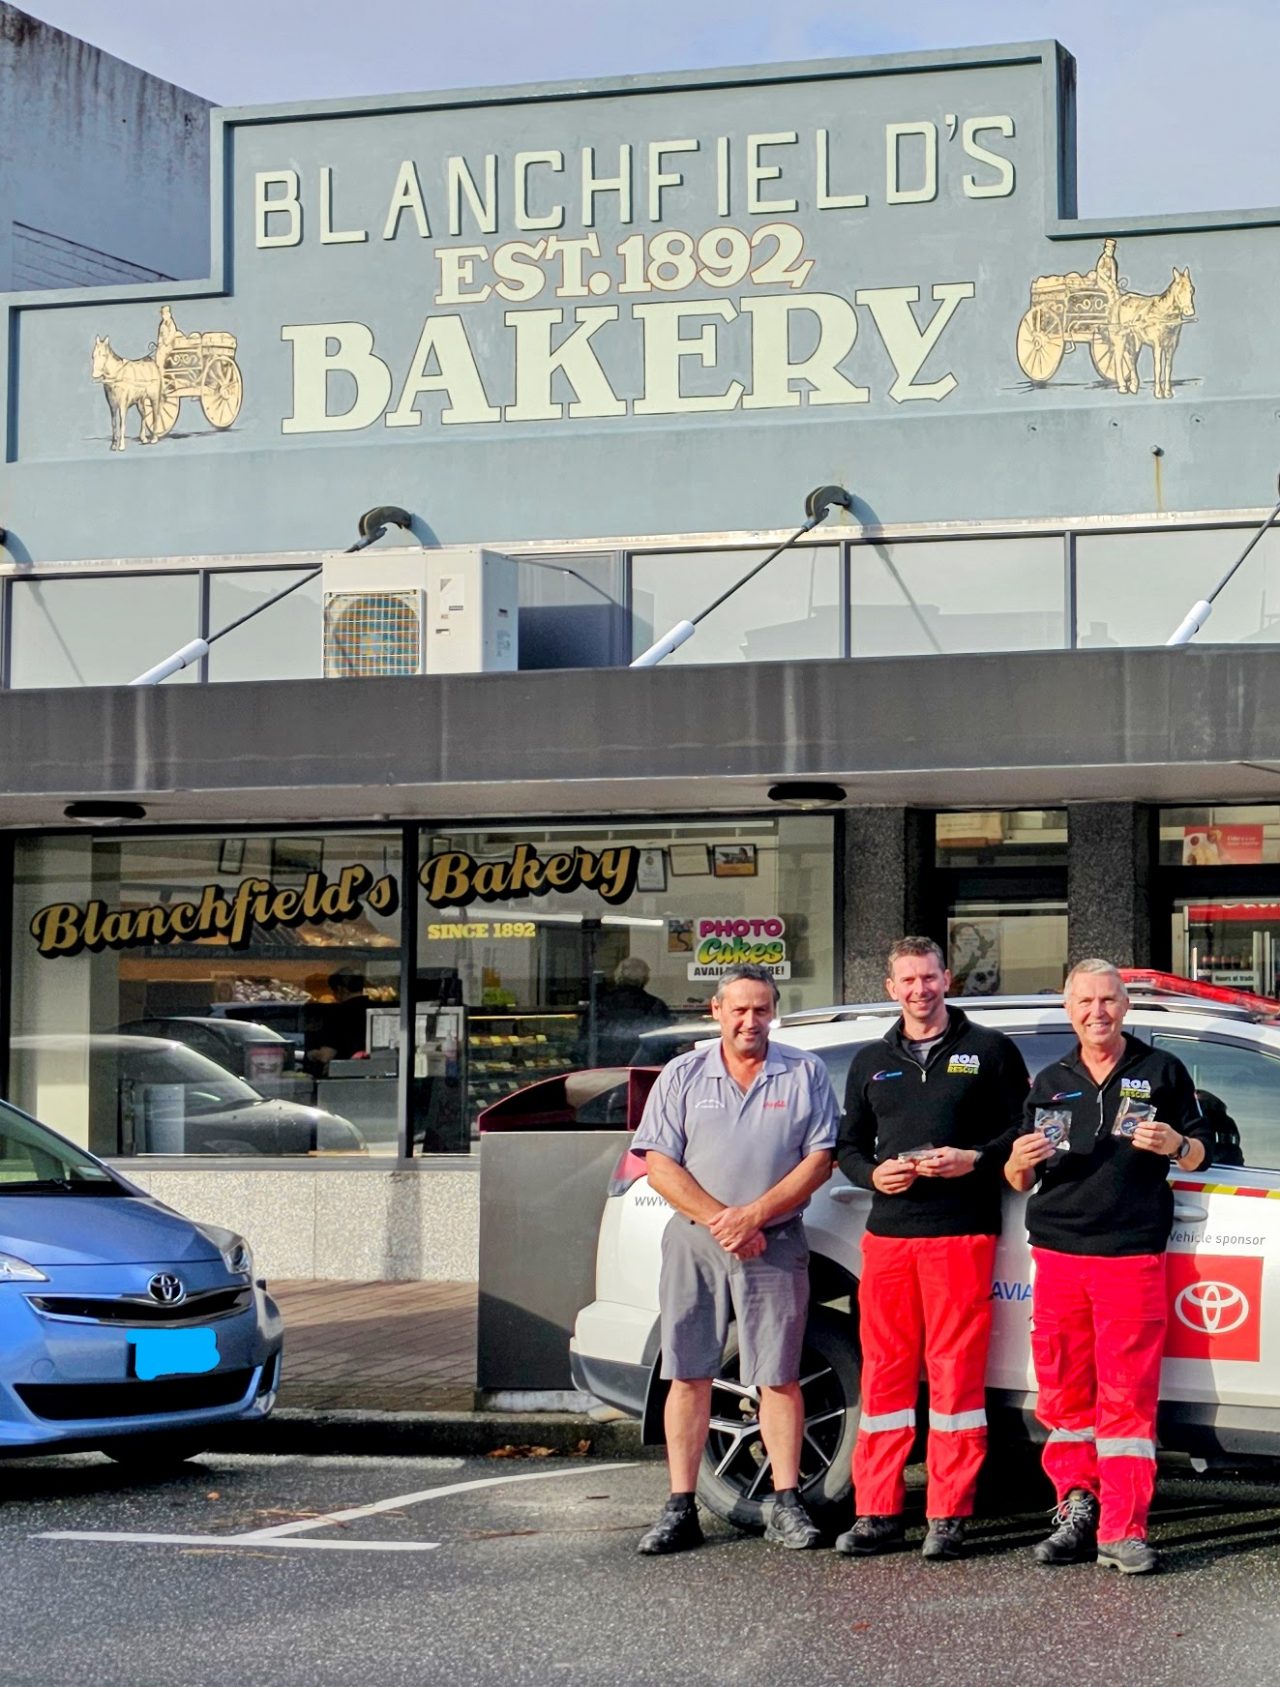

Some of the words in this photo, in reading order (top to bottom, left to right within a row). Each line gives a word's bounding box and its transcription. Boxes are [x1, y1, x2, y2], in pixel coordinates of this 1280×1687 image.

[254, 114, 1018, 249] BLANCHFIELD'S
[281, 282, 976, 435] BAKERY
[29, 863, 402, 961] Blanchfield's
[418, 842, 641, 909] Bakery
[427, 923, 489, 940] SINCE
[493, 922, 536, 938] 1892
[699, 918, 783, 938] PHOTO
[697, 937, 784, 965] Cakes
[950, 1053, 979, 1065] ROA
[1121, 1078, 1151, 1090] ROA
[1215, 1234, 1266, 1247] sponsor
